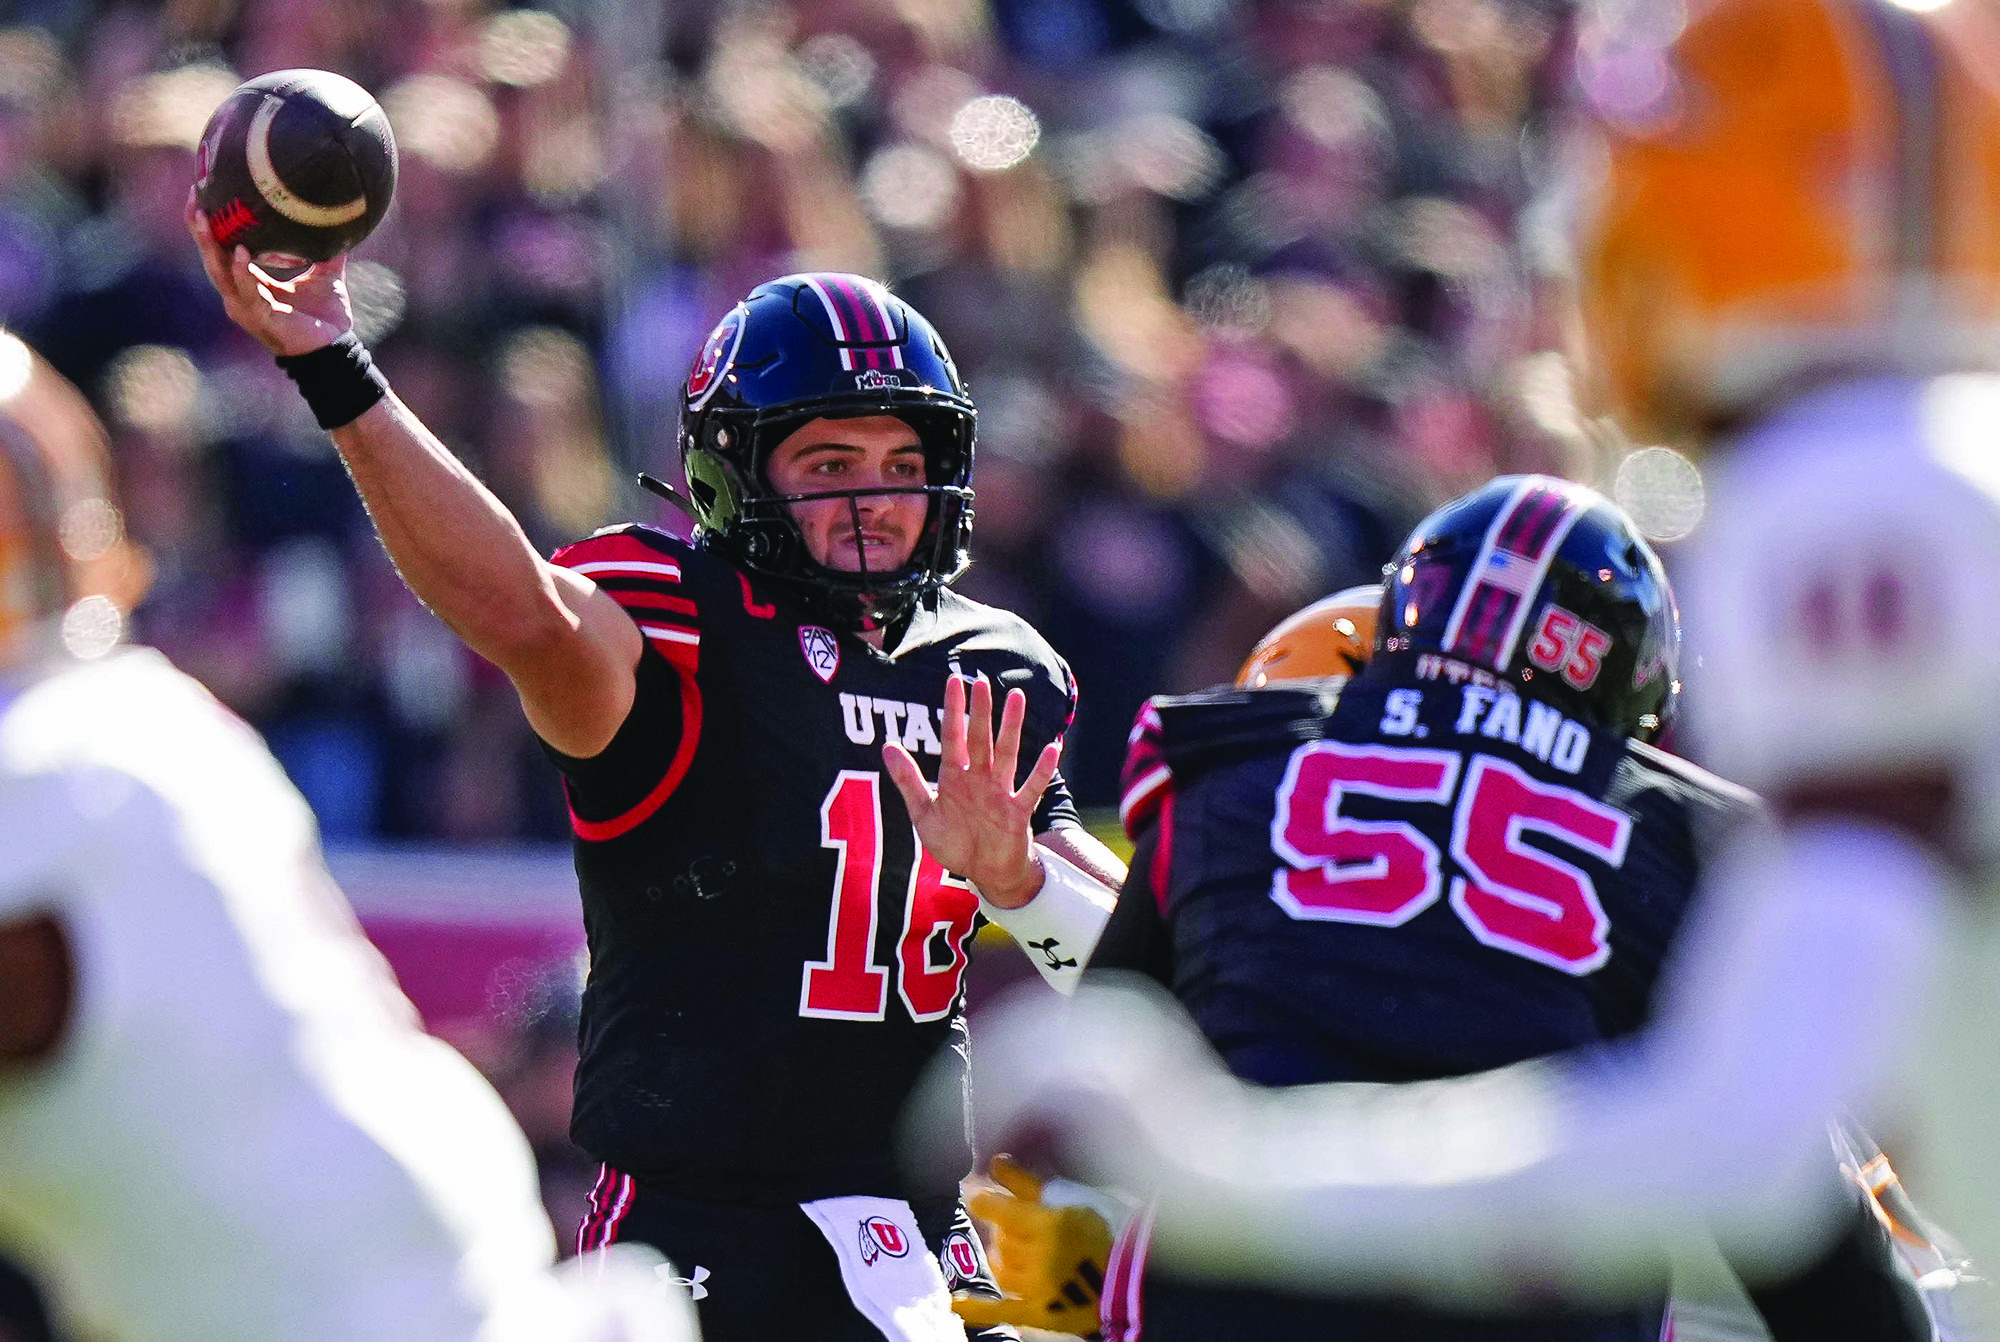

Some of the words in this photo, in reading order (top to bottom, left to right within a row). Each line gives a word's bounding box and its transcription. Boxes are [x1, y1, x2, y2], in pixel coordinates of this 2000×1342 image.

[812, 649, 832, 669] 12
[1526, 602, 1613, 691] 55
[838, 692, 971, 755] UTA
[1379, 688, 1430, 738] S.
[1455, 683, 1591, 774] FANO
[1268, 738, 1633, 977] 55
[799, 769, 980, 1023] 16
[870, 1223, 903, 1252] U
[950, 1243, 975, 1275] U
